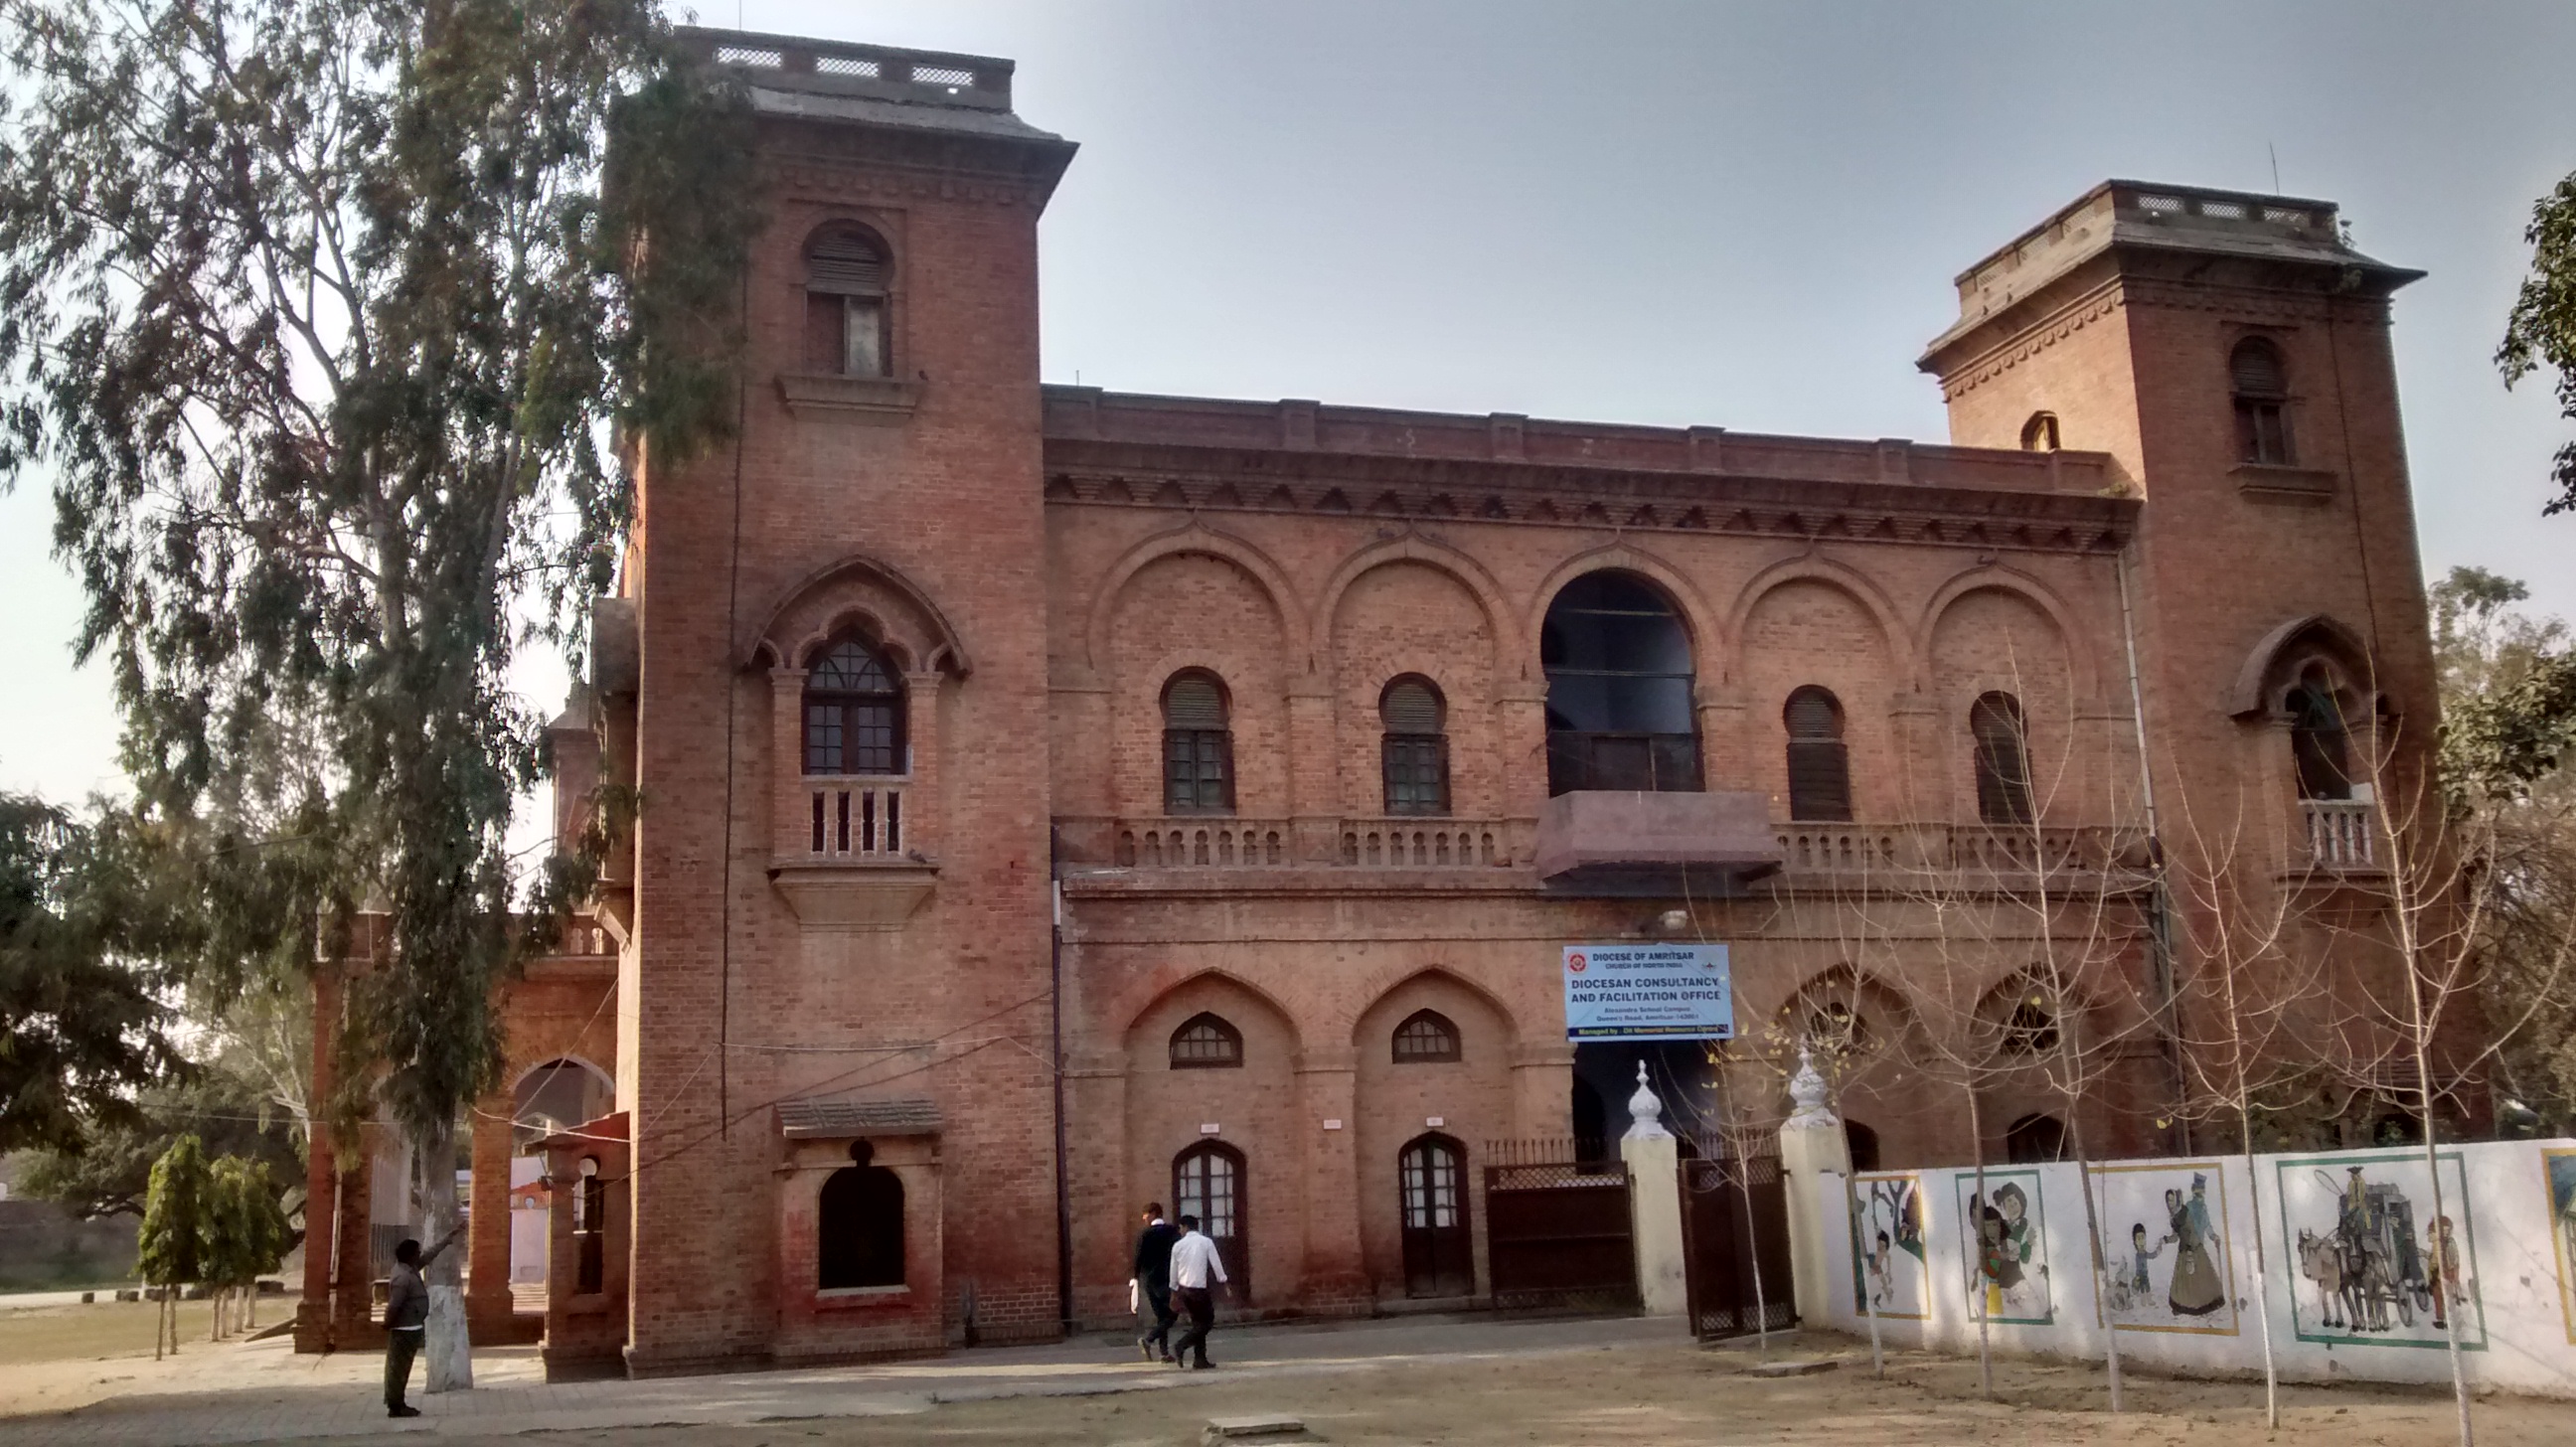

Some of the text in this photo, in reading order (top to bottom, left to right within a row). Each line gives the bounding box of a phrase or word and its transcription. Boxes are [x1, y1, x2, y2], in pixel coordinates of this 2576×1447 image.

[1592, 952, 1632, 962] DIOCESE
[1634, 952, 1646, 961] OF
[1571, 977, 1719, 990] DIOCESAN CONSULTANCY
[1571, 991, 1721, 1004] AND FACILITATION OFFICE
